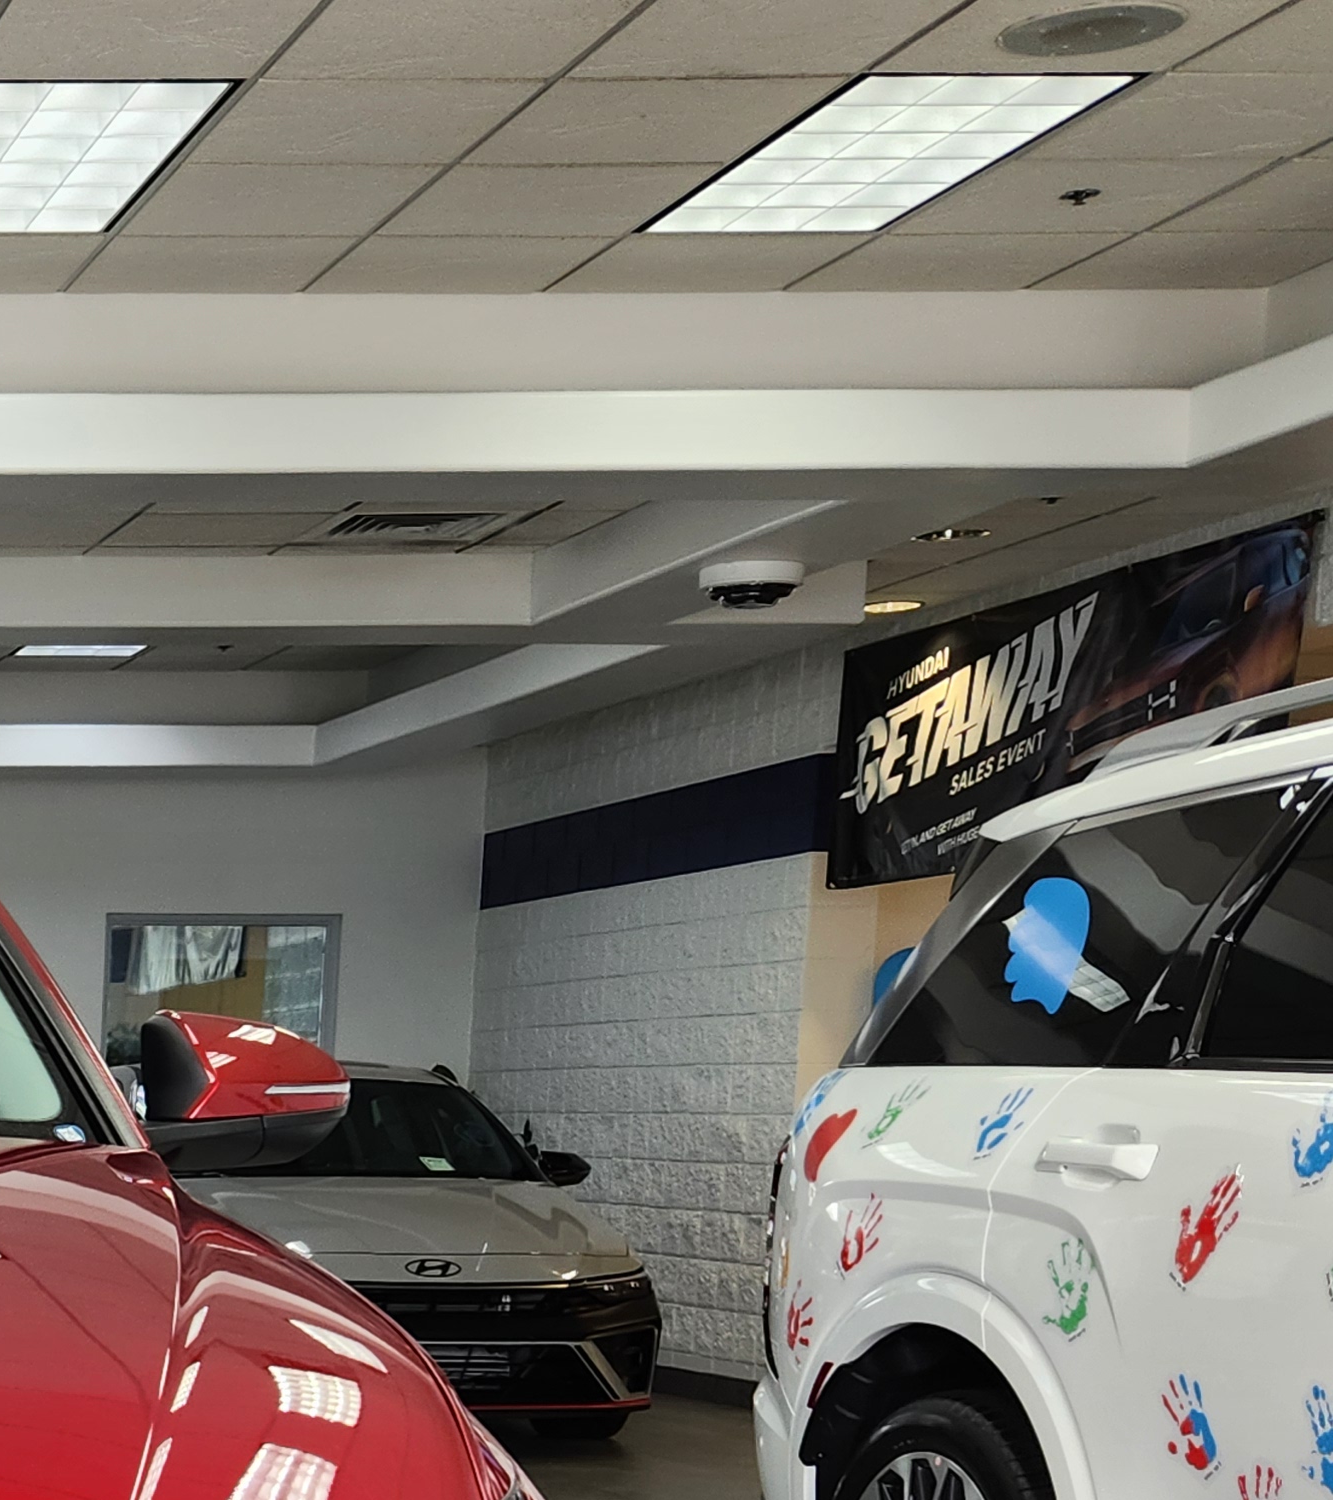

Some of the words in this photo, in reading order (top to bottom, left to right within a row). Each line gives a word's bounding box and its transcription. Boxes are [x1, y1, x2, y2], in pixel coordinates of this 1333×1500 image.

[839, 591, 1099, 814] GETAWAY
[886, 646, 951, 699] HYUNDAI
[948, 758, 994, 796] SALES
[995, 728, 1047, 772] EVENT
